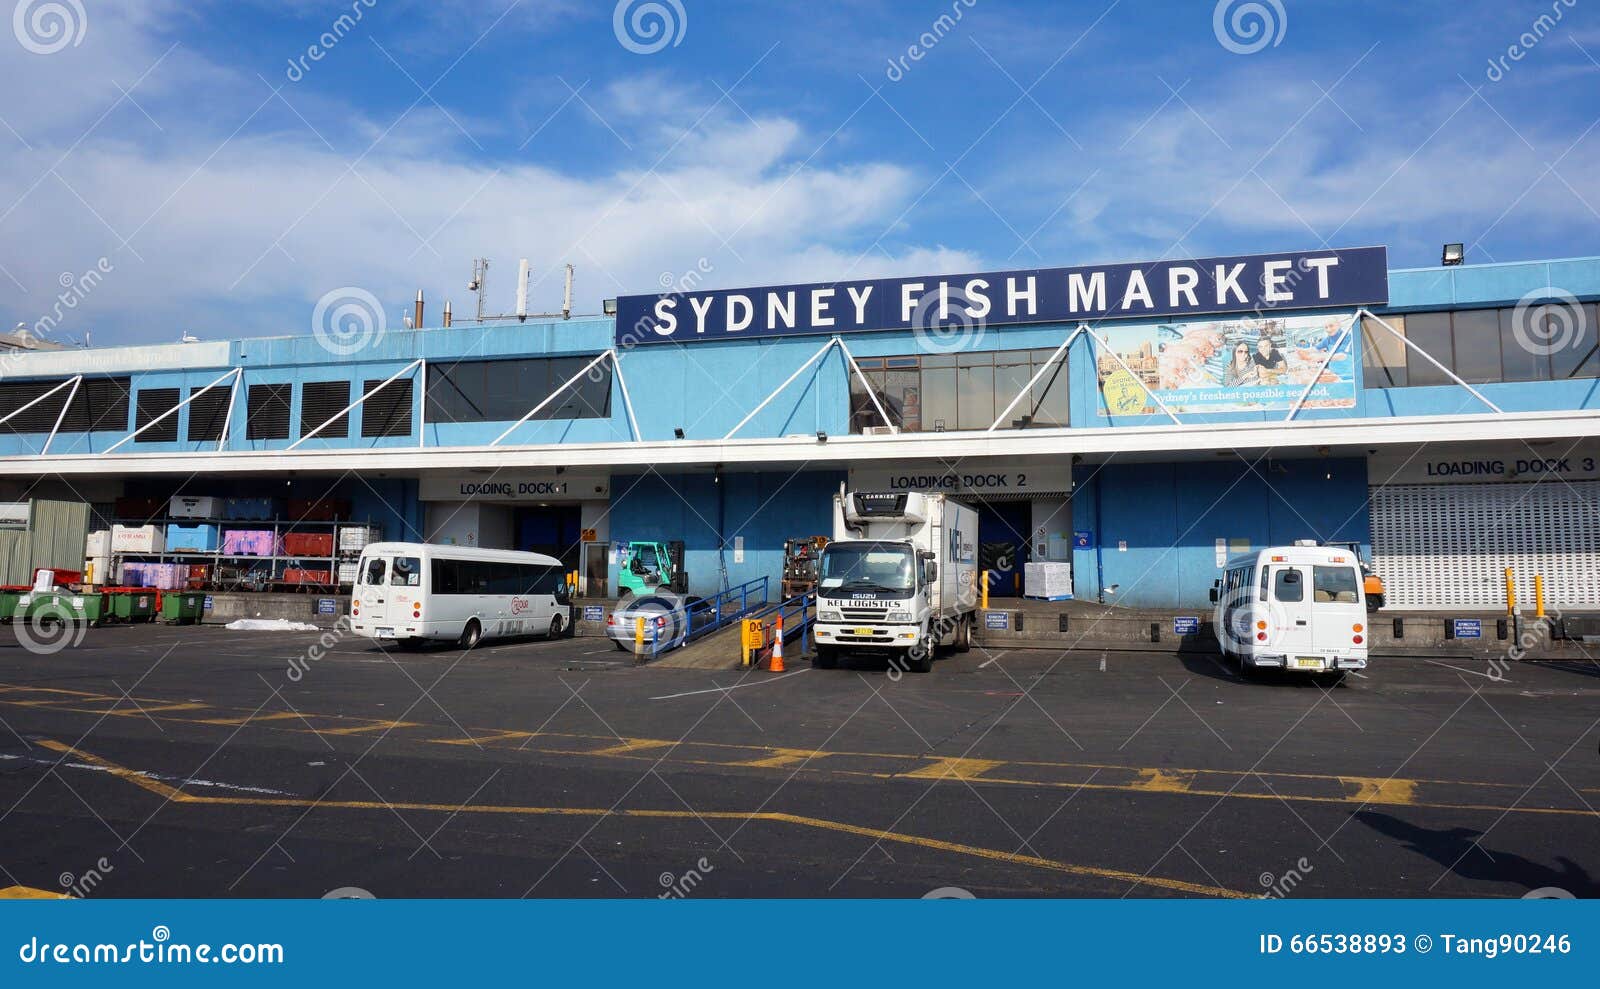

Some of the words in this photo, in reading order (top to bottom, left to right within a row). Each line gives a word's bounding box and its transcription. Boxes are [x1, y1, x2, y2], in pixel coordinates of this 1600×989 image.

[653, 285, 873, 336] SYDNEY
[901, 275, 1037, 322] FISH
[1068, 256, 1339, 313] MARKET
[1200, 391, 1240, 401] freshest
[1243, 389, 1283, 402] possible
[1287, 386, 1330, 398] seaood.
[1427, 460, 1504, 476] LOADING
[1516, 458, 1571, 473] DOCK
[1583, 458, 1595, 472] 3
[460, 483, 511, 495] LOADING
[518, 482, 553, 494] DOCK
[561, 483, 567, 494] 1
[890, 475, 953, 489] LOADING
[963, 474, 1008, 488] DOCK
[1017, 474, 1026, 486] 2
[848, 600, 901, 608] LOGISTICS
